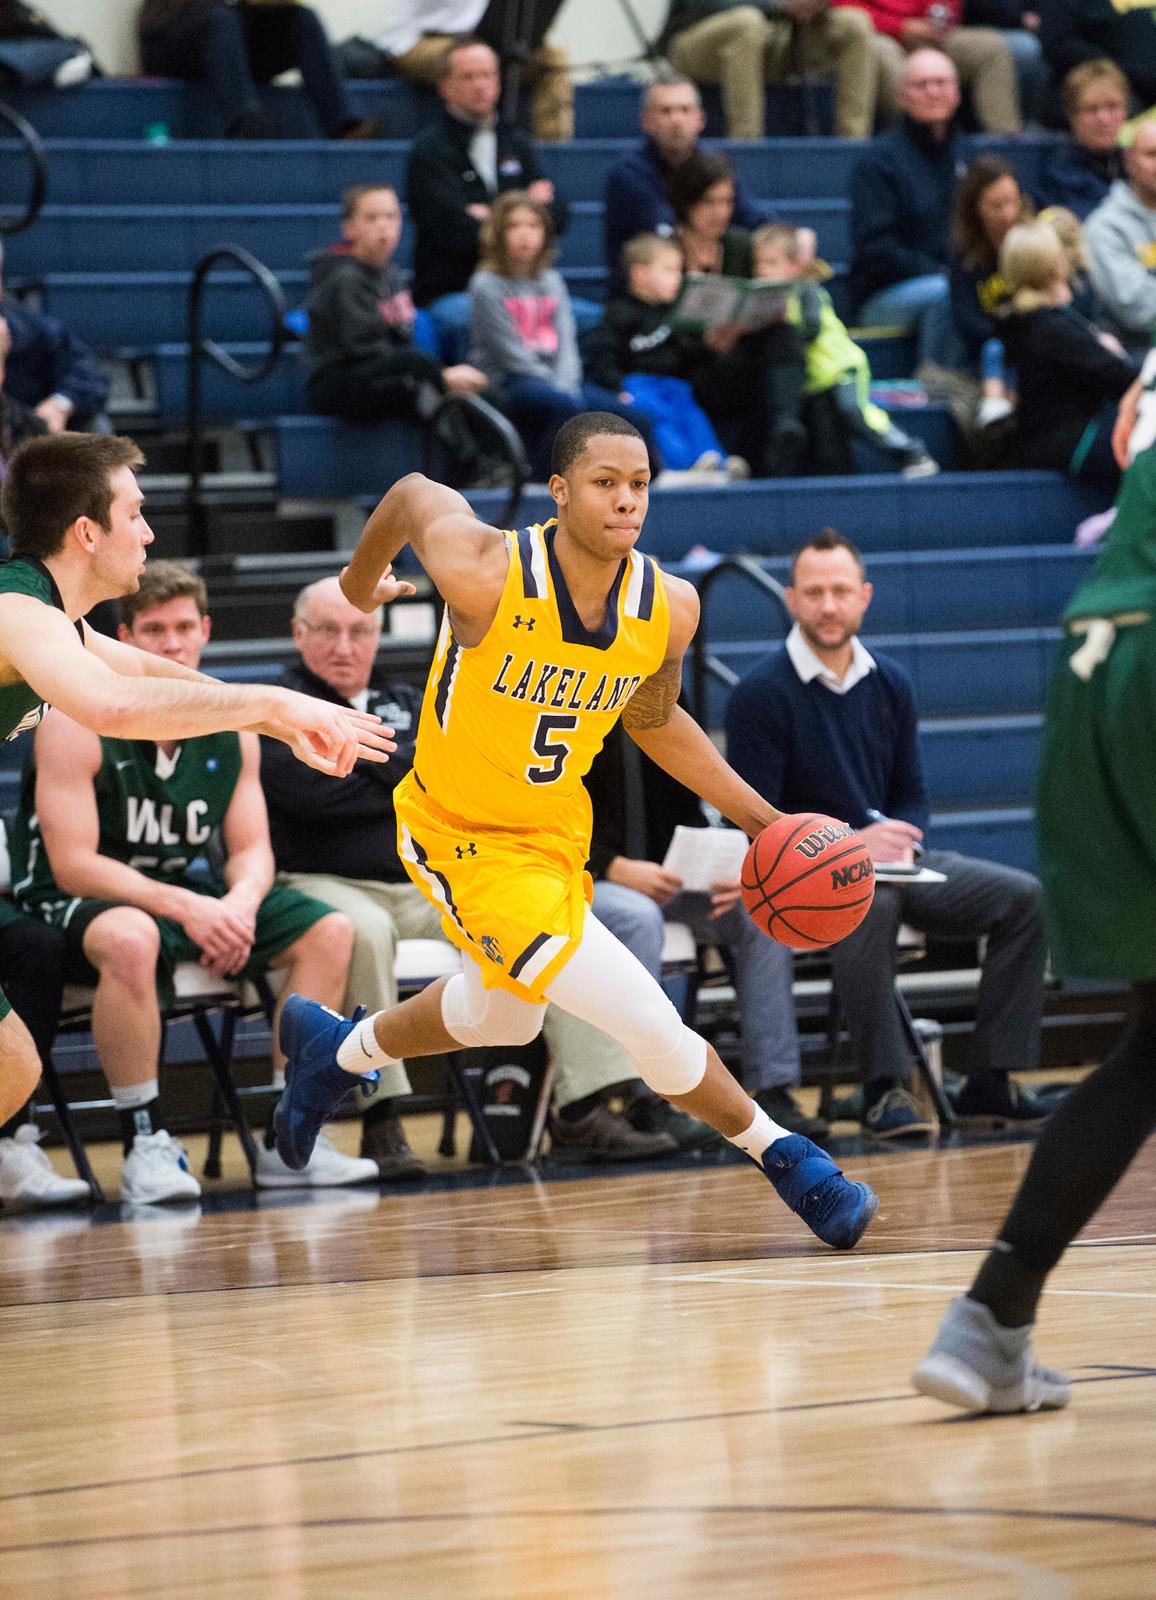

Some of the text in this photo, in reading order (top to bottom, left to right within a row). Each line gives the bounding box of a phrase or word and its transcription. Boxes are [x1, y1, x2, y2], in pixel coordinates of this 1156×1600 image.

[525, 711, 579, 786] 5
[127, 796, 210, 845] WLC
[793, 823, 855, 860] Wils
